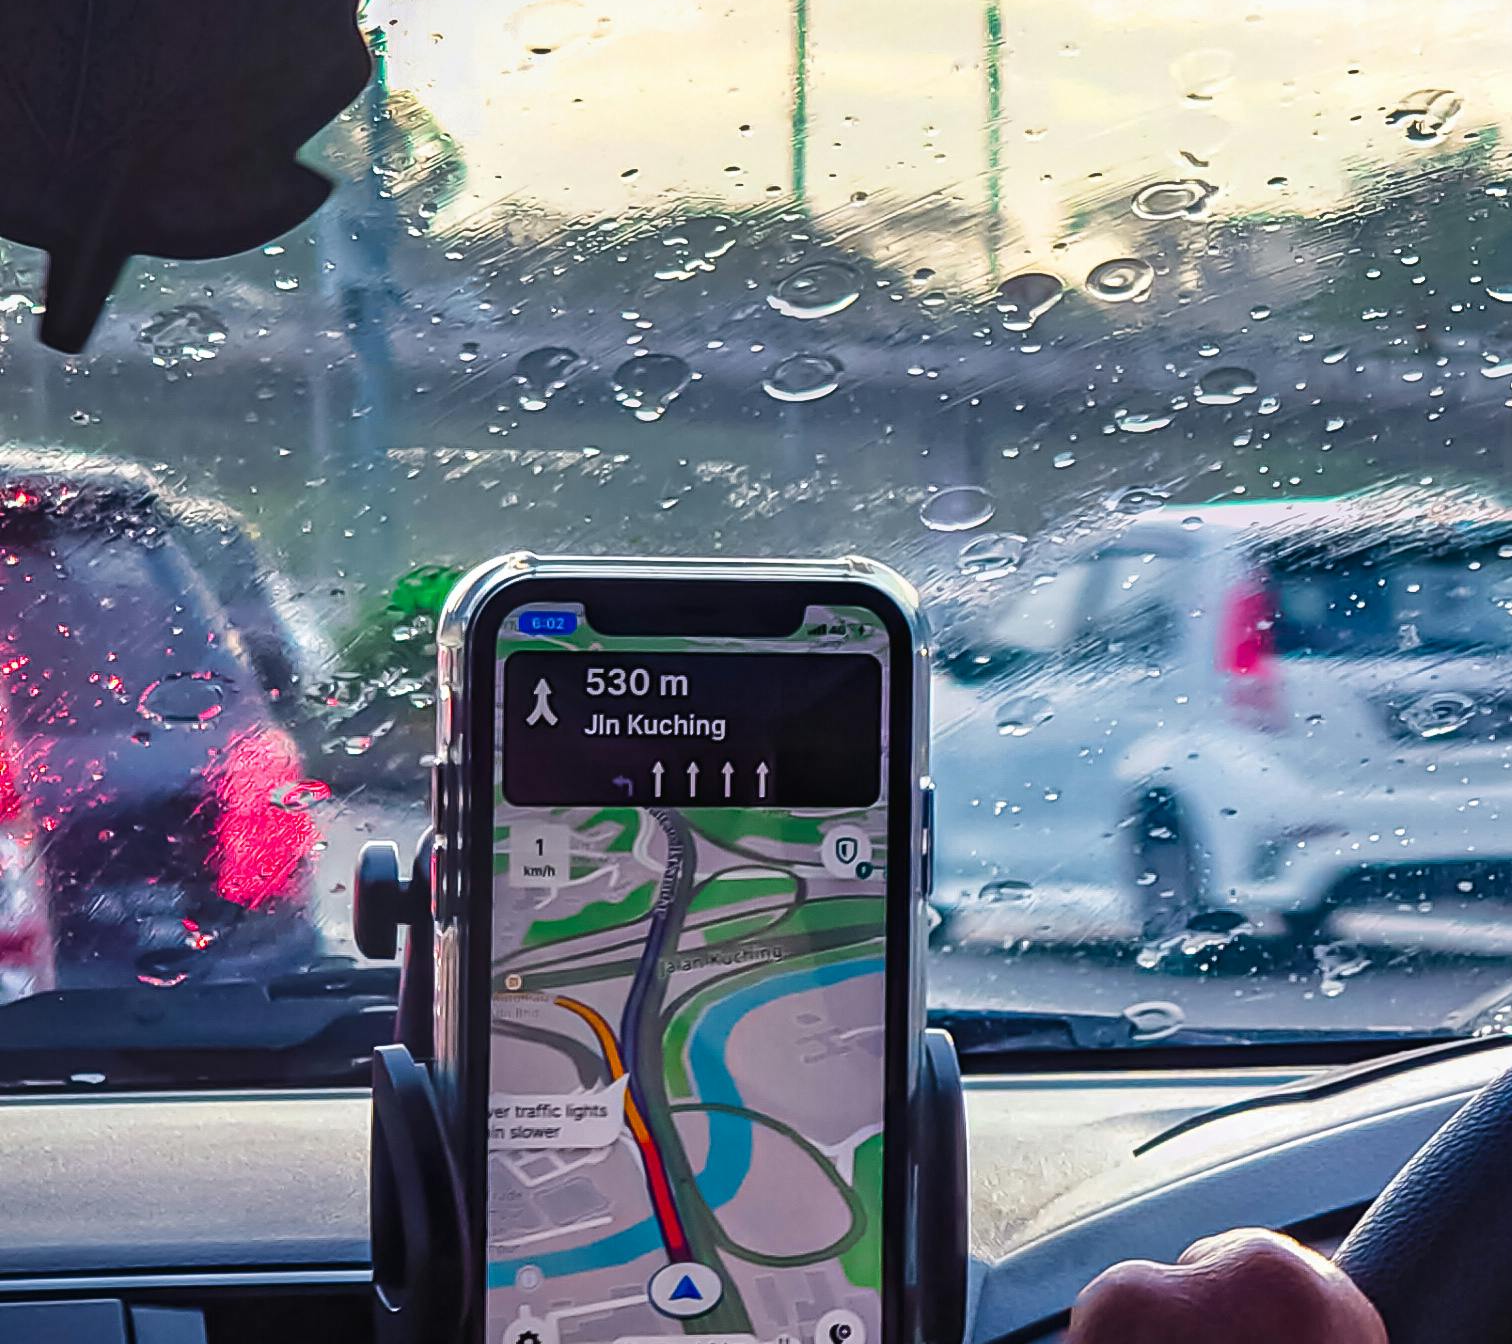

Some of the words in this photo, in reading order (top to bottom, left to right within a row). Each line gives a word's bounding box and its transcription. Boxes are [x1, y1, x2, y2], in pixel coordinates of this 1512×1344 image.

[585, 667, 650, 696] 530
[659, 674, 689, 696] m
[627, 713, 726, 741] Kuching
[535, 838, 544, 857] 1
[523, 863, 557, 879] km/h
[515, 1103, 561, 1119] traffic
[565, 1102, 608, 1122] lights
[510, 1125, 562, 1140] slower
